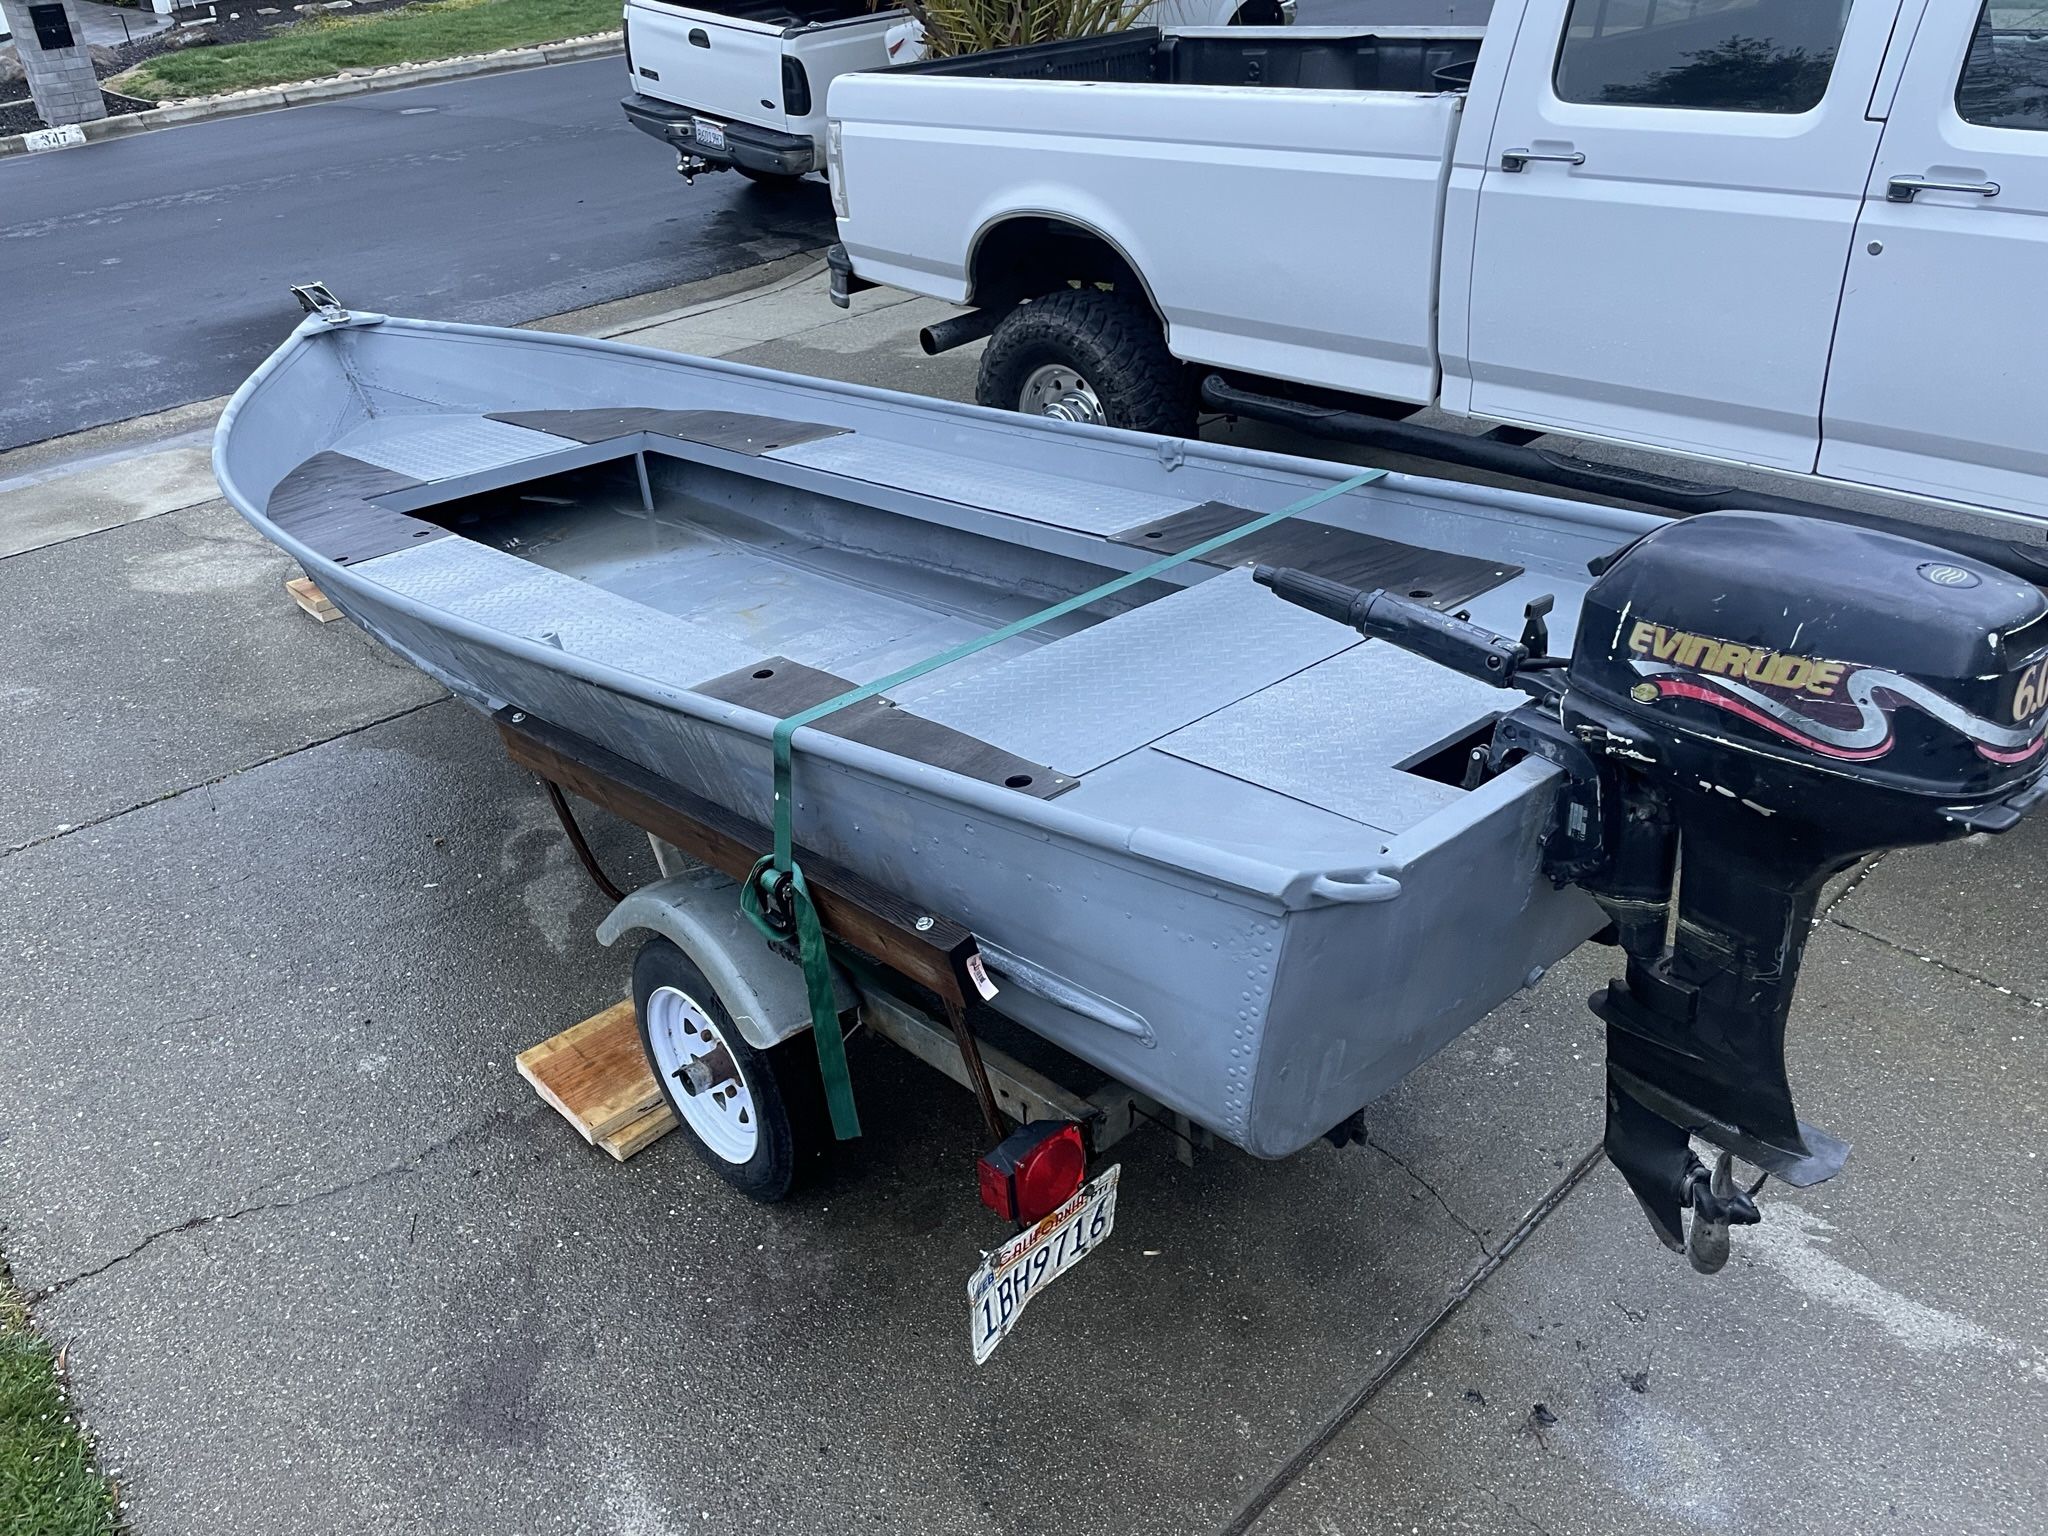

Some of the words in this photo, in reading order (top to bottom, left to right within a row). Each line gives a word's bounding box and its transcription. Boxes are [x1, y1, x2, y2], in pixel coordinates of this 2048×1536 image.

[40, 131, 67, 147] 347
[1629, 622, 1844, 695] EVINRUDE
[1000, 1192, 1086, 1266] CALIFORNIA
[982, 1197, 1106, 1344] 1BH9716
